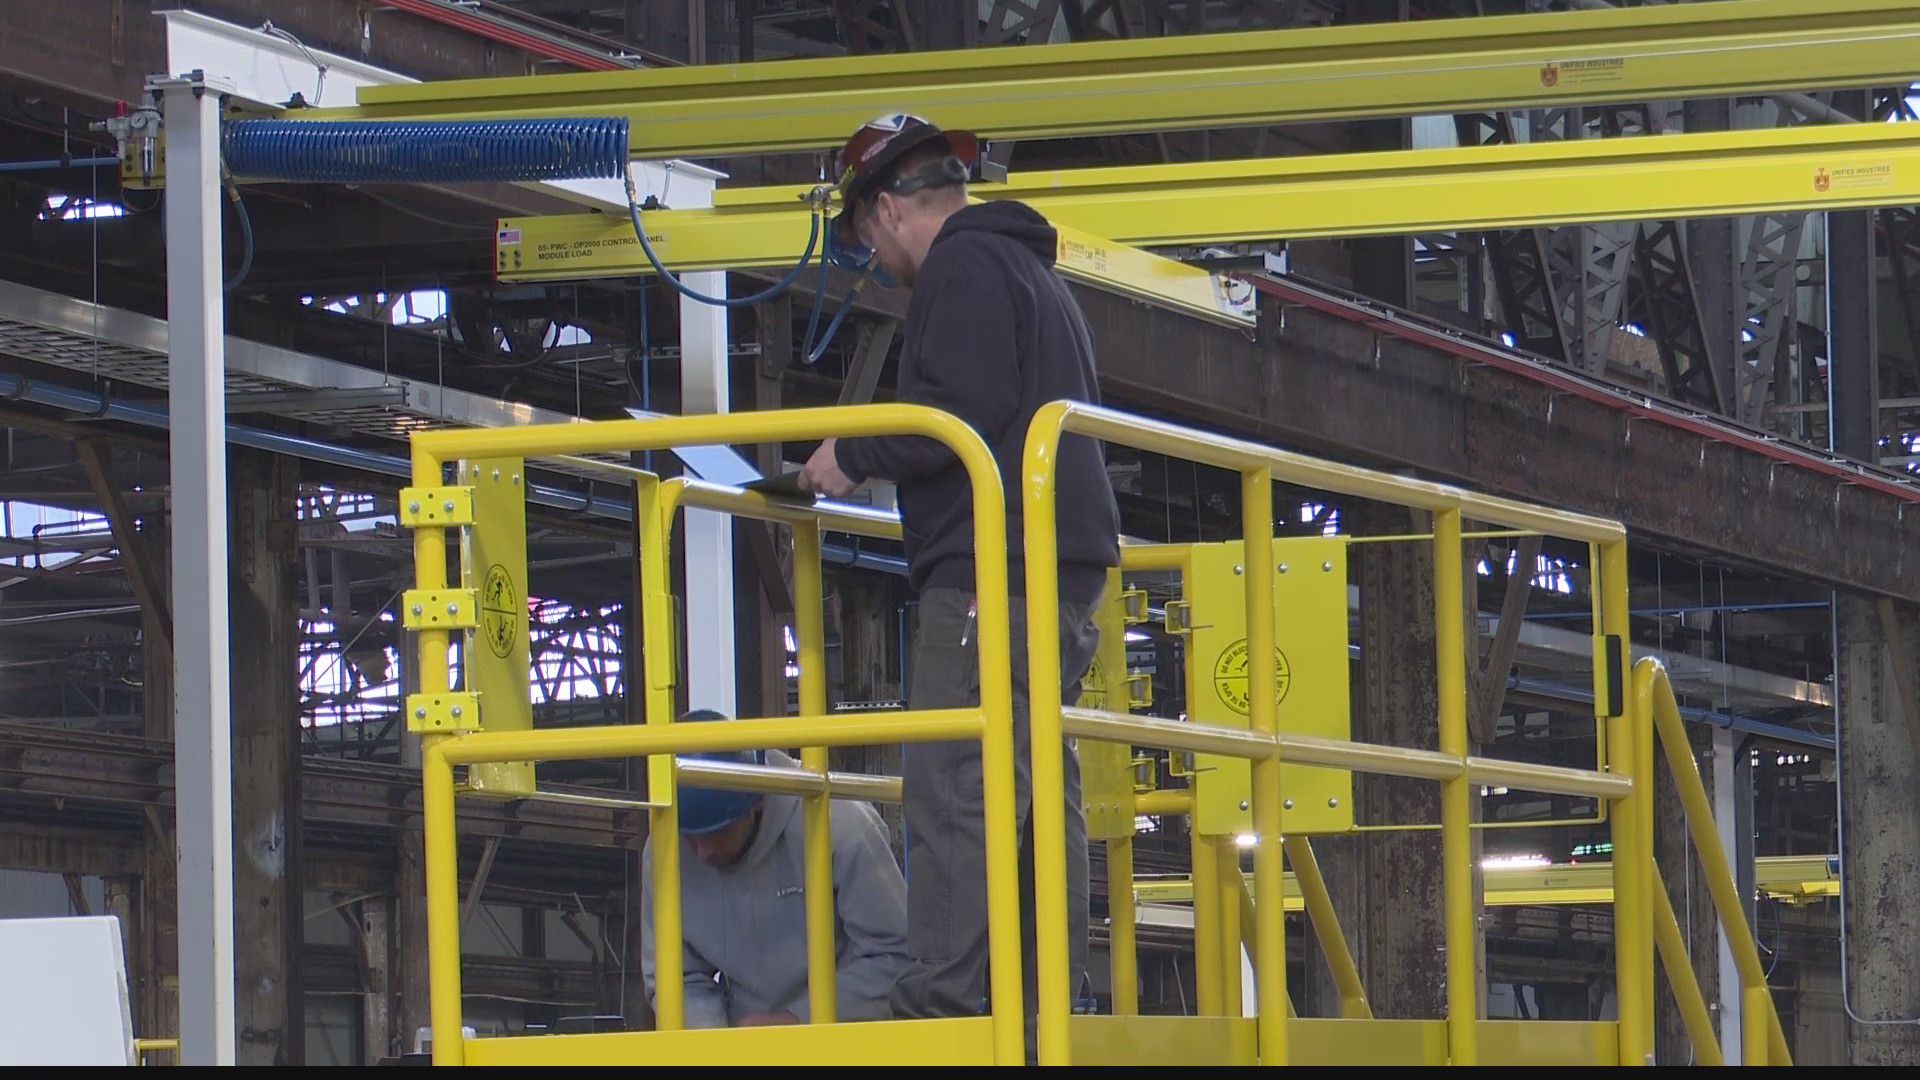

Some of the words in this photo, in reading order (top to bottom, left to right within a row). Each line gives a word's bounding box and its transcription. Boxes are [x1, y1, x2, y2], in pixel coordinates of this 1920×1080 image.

[1831, 168, 1855, 176] UNIFIED
[1856, 166, 1890, 174] INDUSTRIES
[551, 243, 568, 251] PWC
[574, 240, 600, 249] OP2000
[602, 238, 638, 246] CONTROL
[646, 235, 664, 243] ANEL
[539, 252, 570, 260] MODULE
[571, 250, 592, 258] LOAD
